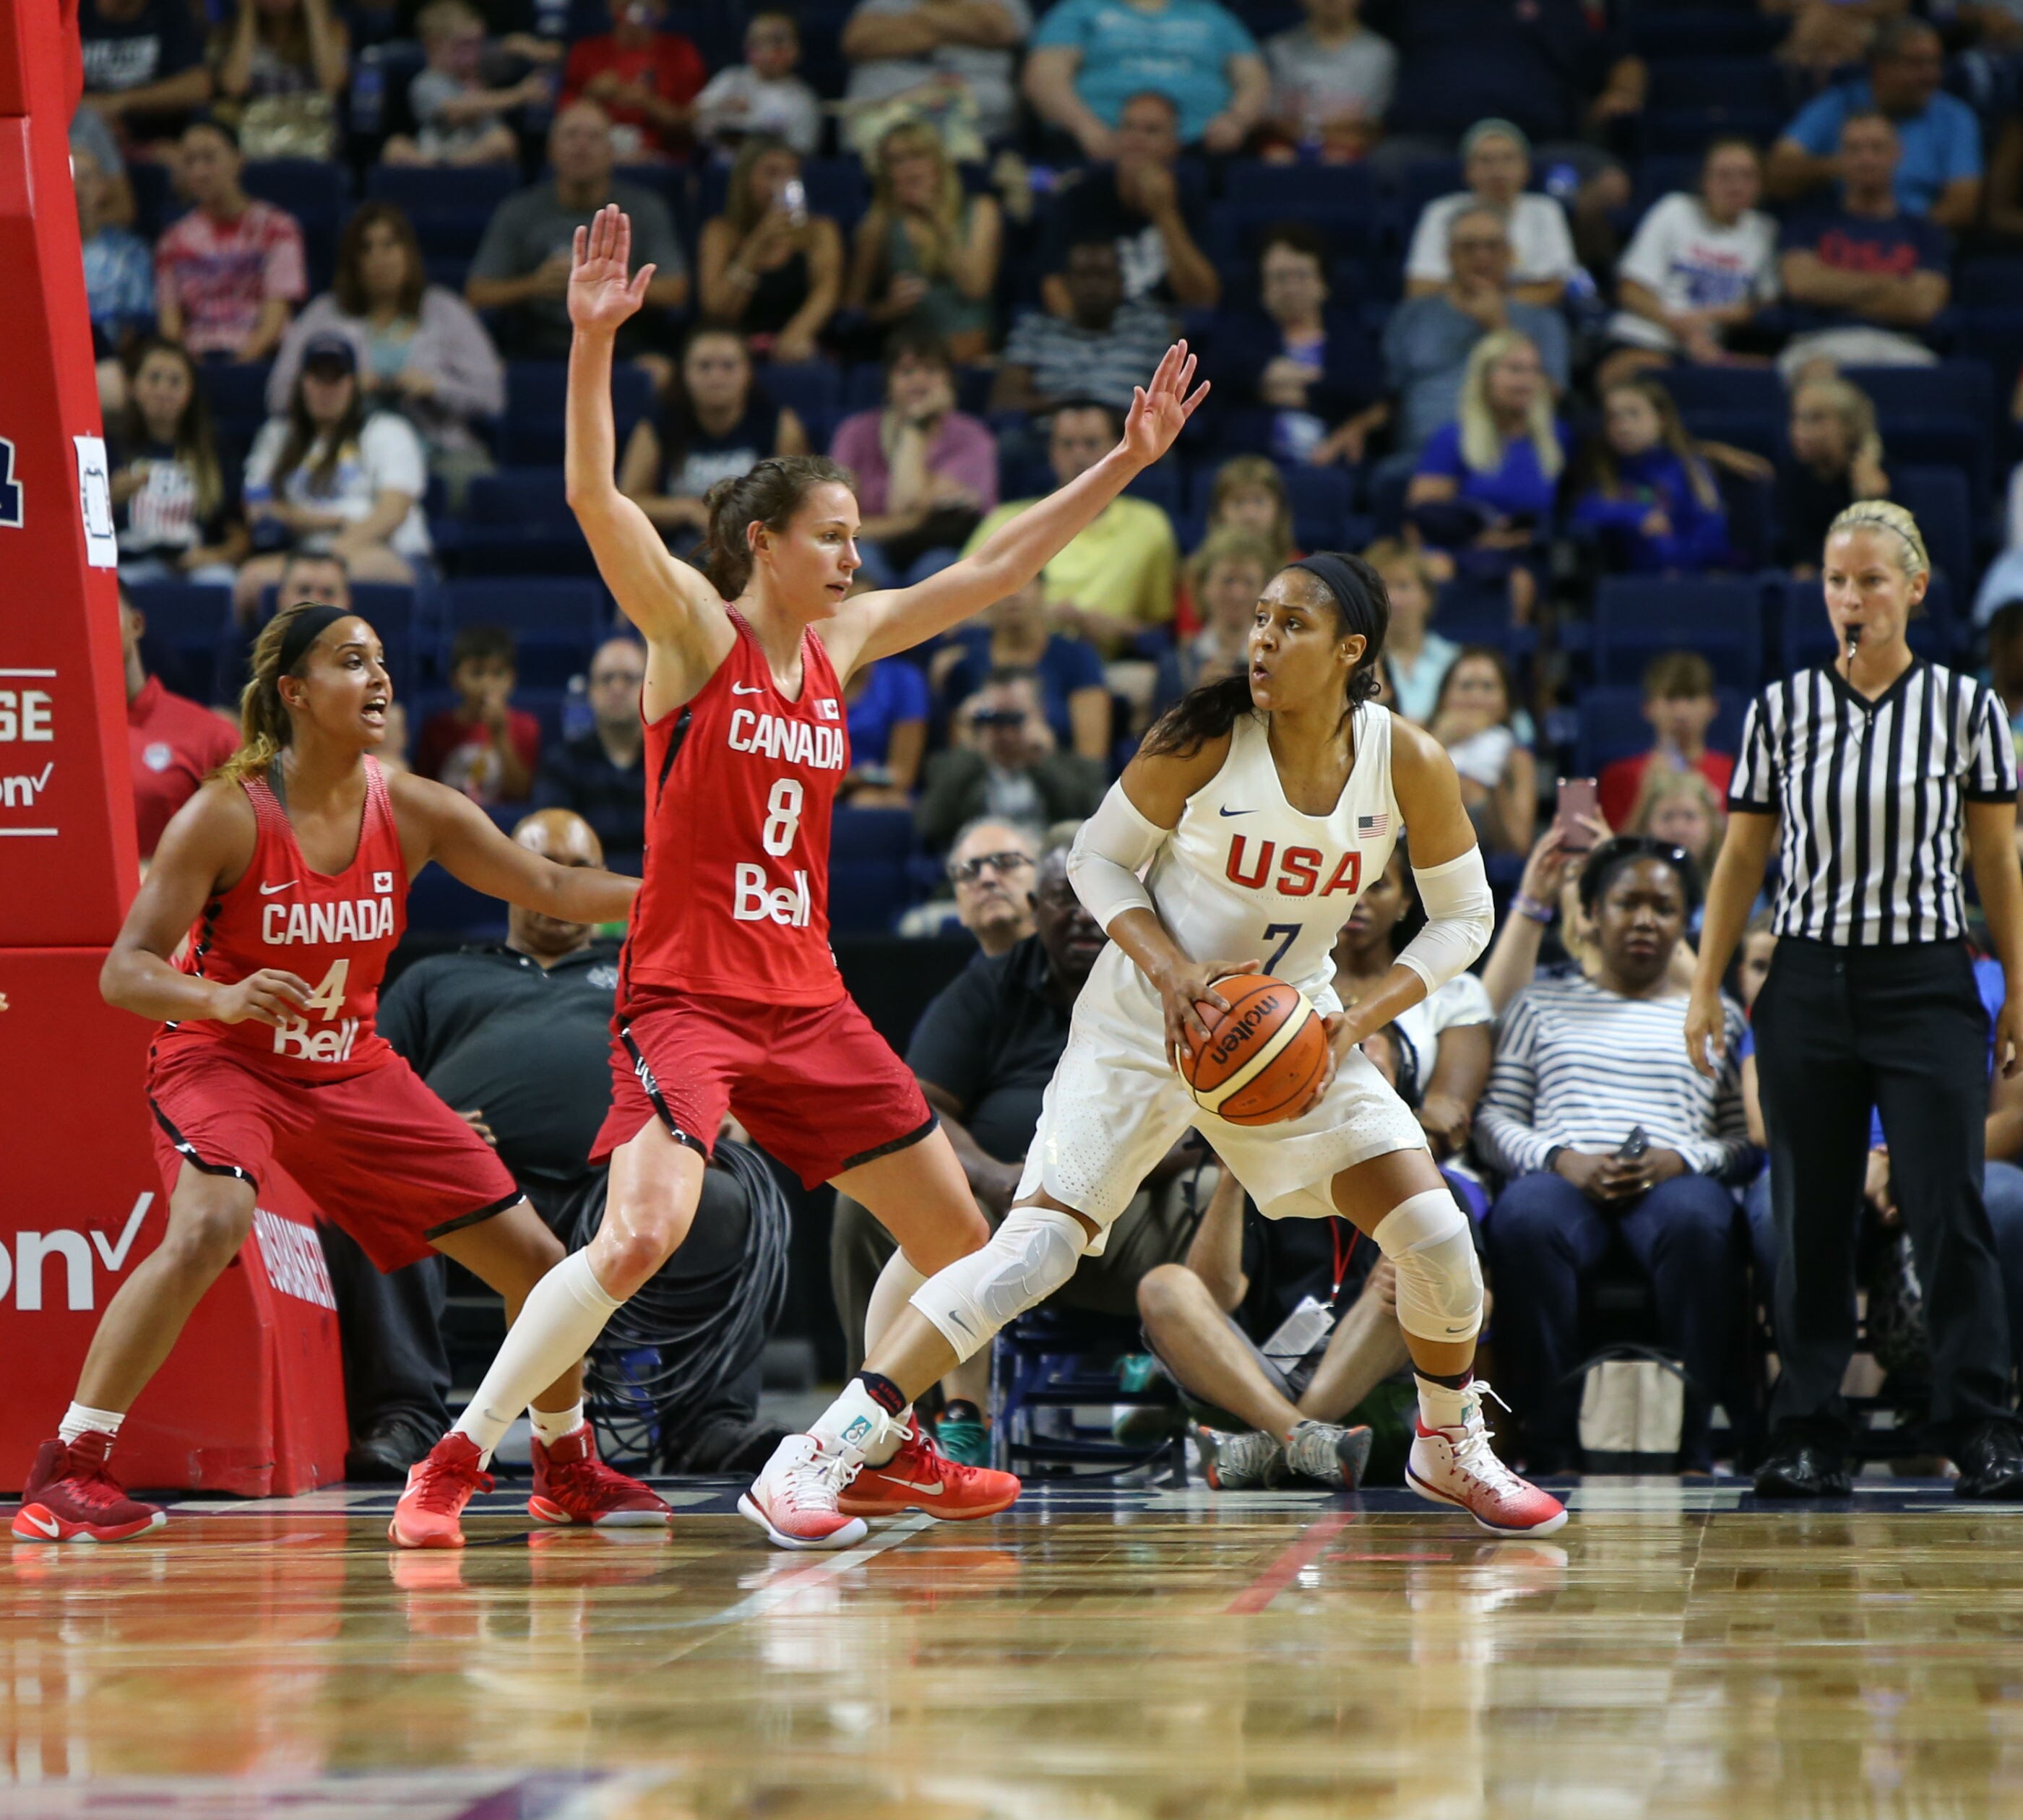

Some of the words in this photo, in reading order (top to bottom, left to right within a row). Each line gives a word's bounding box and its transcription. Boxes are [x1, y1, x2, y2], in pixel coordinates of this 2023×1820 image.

[728, 708, 844, 770] CANADA
[762, 777, 804, 857] 8
[733, 862, 811, 927] Bell
[1225, 833, 1362, 897] USA
[262, 897, 394, 945] CANADA
[1262, 923, 1303, 976] 7
[309, 959, 350, 1022] 4
[272, 1016, 360, 1063] Bell
[1210, 995, 1280, 1065] molten
